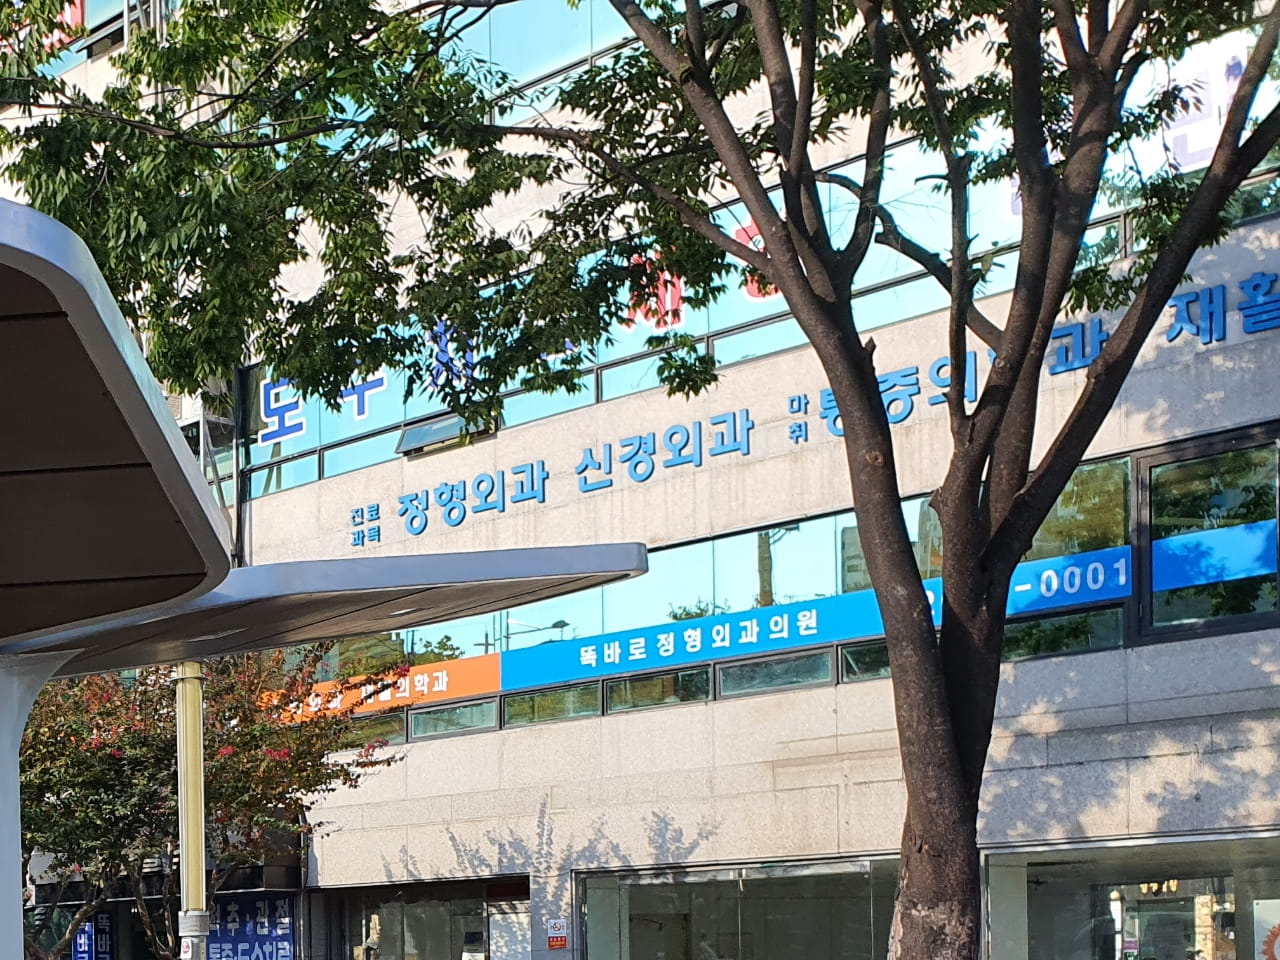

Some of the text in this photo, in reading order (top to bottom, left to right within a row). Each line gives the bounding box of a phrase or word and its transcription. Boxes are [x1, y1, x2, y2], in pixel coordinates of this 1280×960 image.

[398, 408, 754, 535] 정형외과 신경외과
[350, 503, 380, 526] 진료
[351, 525, 381, 547] 과목
[579, 609, 818, 667] 똑바로정형외과의원
